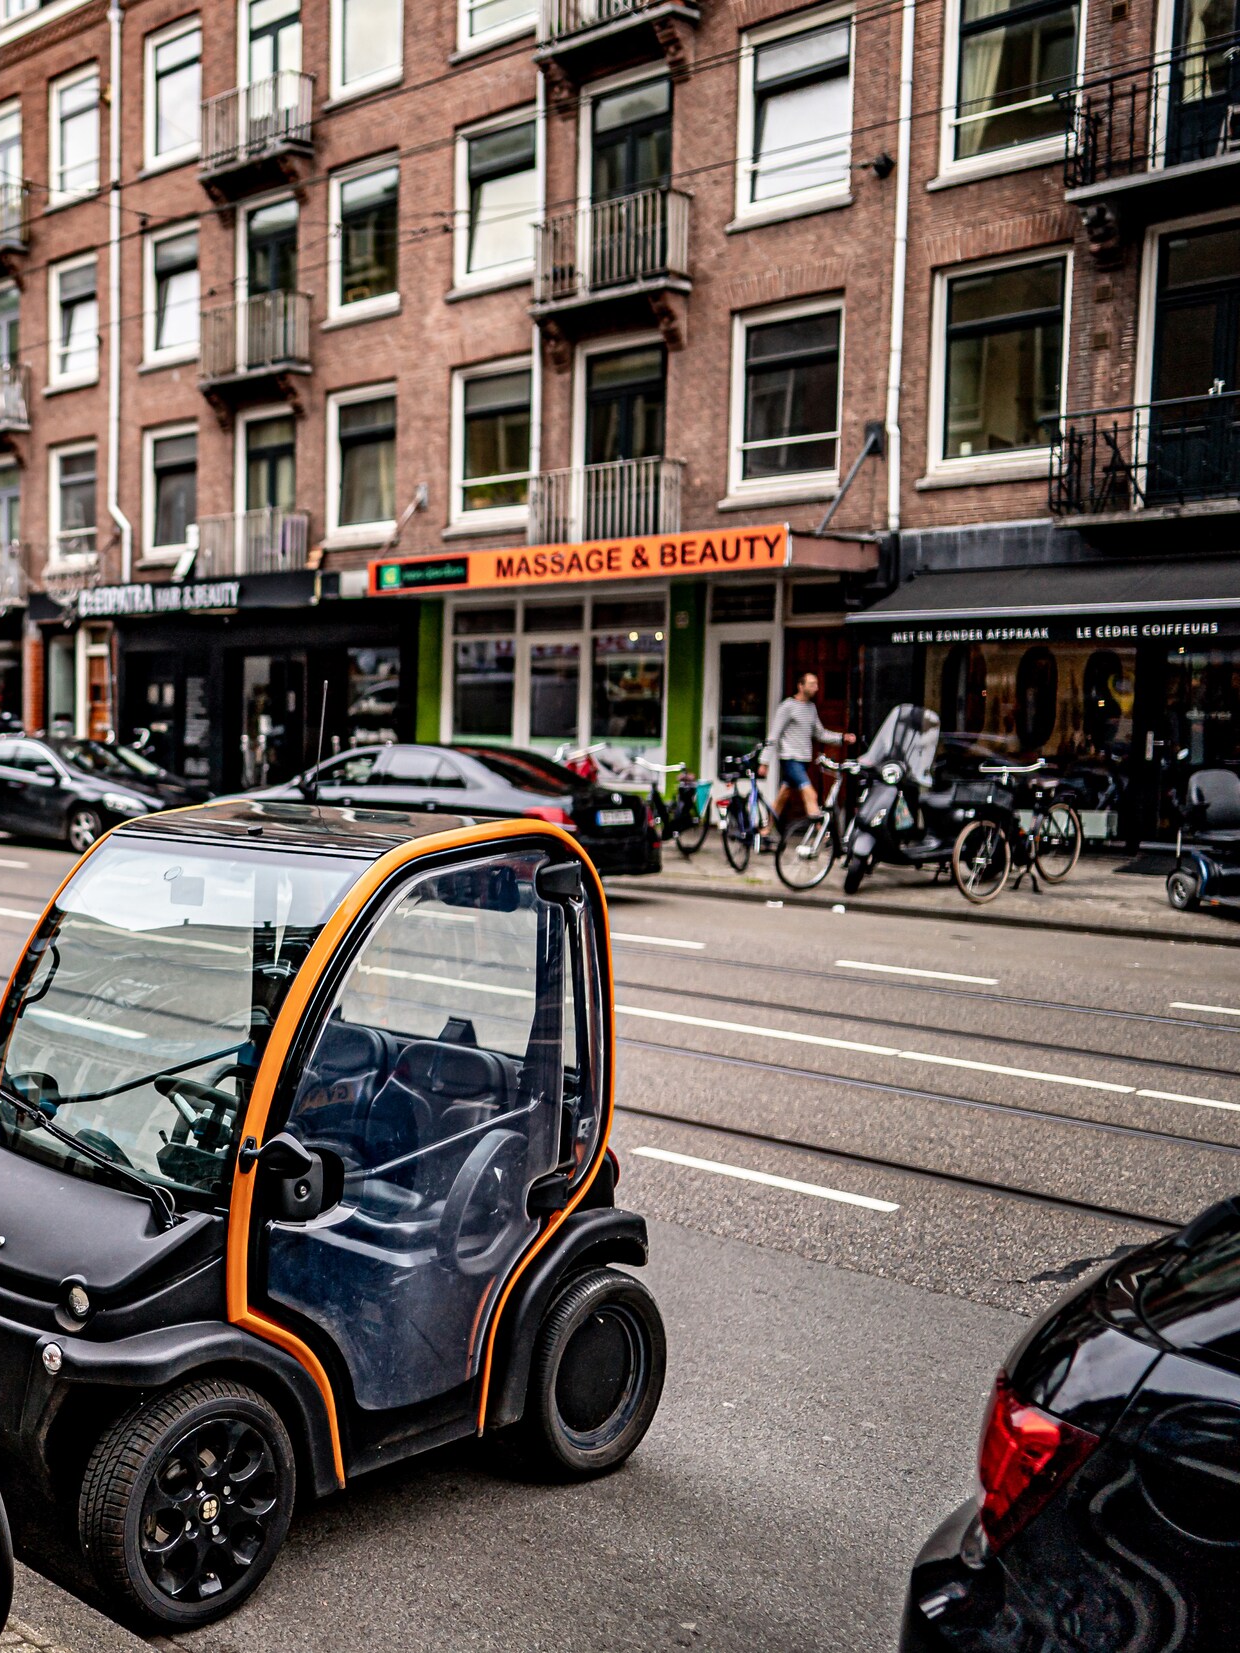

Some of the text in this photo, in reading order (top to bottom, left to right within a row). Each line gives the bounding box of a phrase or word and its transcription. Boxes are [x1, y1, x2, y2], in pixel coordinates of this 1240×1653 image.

[495, 545, 621, 580] MASSAGE
[631, 544, 649, 570] &
[660, 533, 782, 568] BEAUTY
[891, 627, 1050, 644] MET EN ZONDER AFSPRAAK
[1075, 626, 1091, 639] LE
[1142, 622, 1219, 637] COIFFEURS
